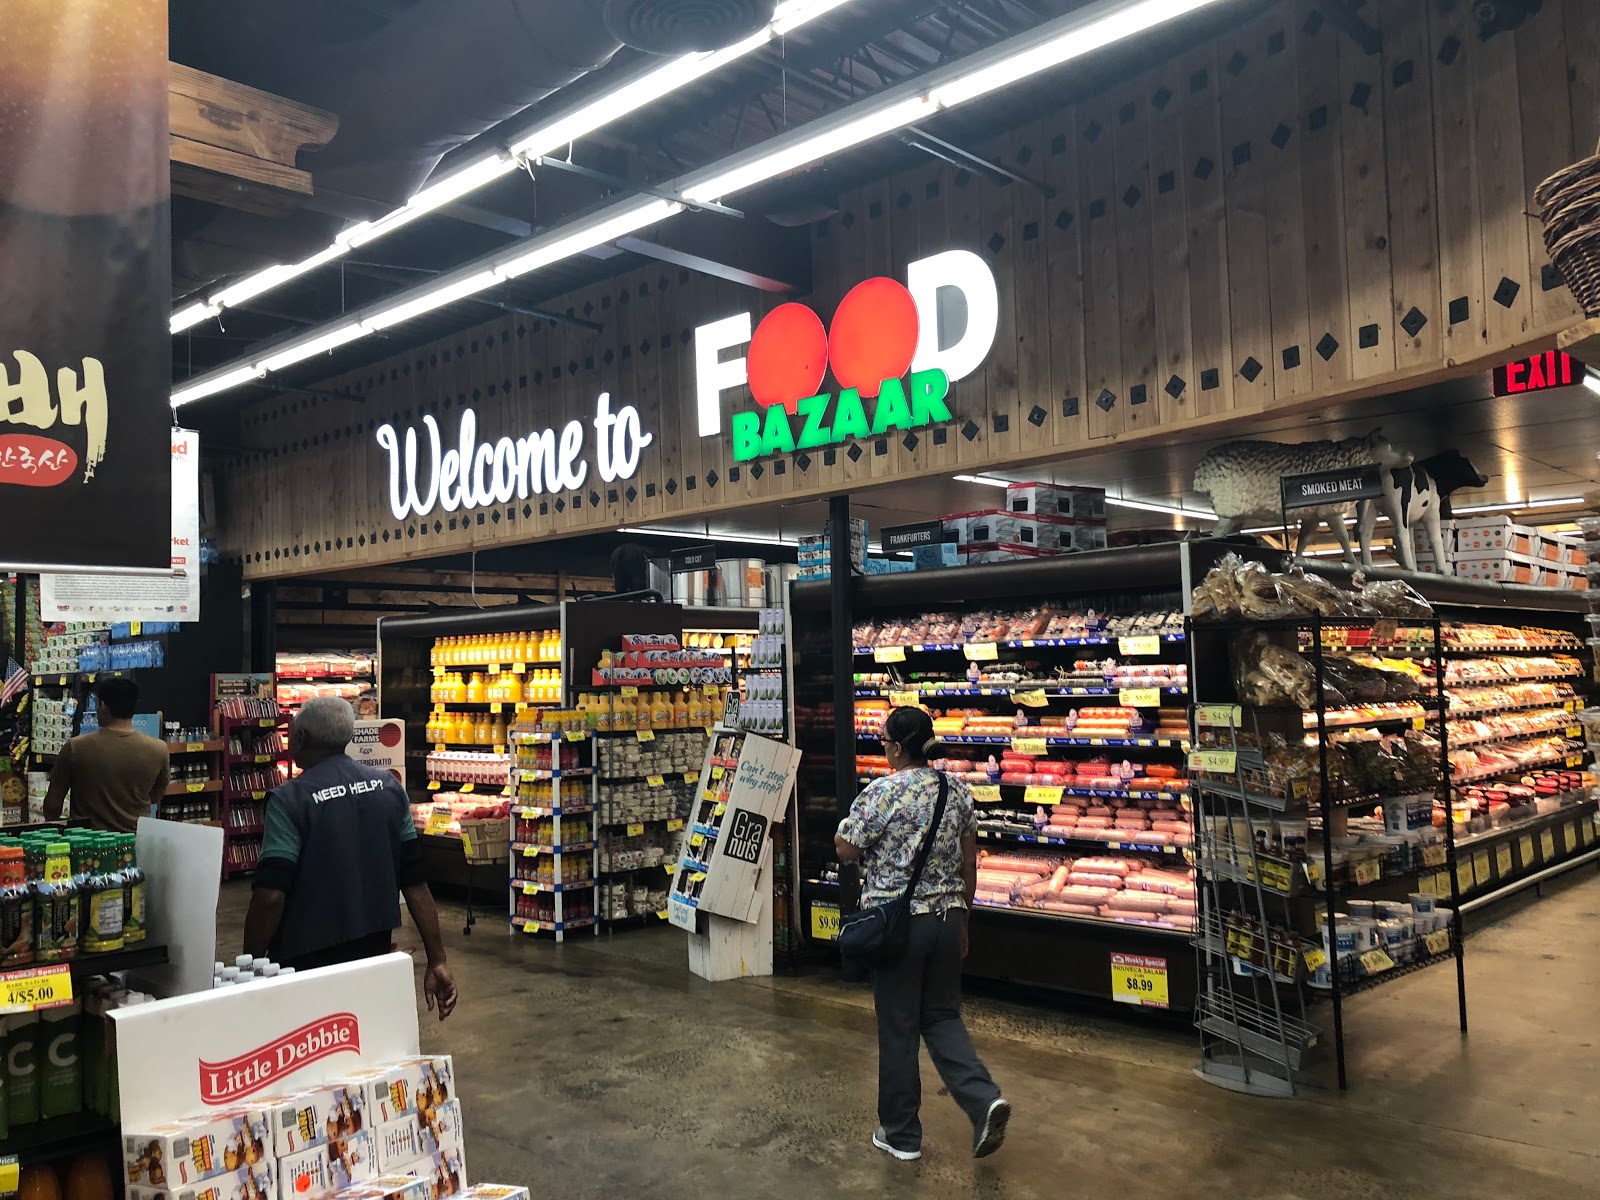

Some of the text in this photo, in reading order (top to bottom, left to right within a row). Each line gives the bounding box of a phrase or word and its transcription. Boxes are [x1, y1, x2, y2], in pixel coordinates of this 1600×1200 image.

[695, 249, 998, 437] FOOD
[1506, 349, 1571, 393] EXIT
[732, 367, 952, 462] BAZAAR
[376, 392, 652, 520] Welcome to
[1301, 478, 1363, 496] SMOKED MEAT
[890, 531, 931, 545] FRANKFURTERS
[685, 556, 694, 564] COLD
[354, 728, 379, 736] SHADE
[354, 735, 380, 743] FARMS
[741, 760, 766, 776] Can't
[312, 779, 384, 804] NEED HELP?
[740, 774, 783, 794] why stop?
[733, 811, 763, 844] Gra
[728, 838, 758, 861] nuts
[1113, 965, 1142, 973] INDUVECA
[1144, 968, 1166, 976] SALAMI
[1125, 956, 1165, 968] Weekly Special
[7, 965, 67, 981] Weekly Special
[1127, 977, 1153, 991] $8.99
[8, 986, 54, 1004] 4/$5.00
[209, 1023, 350, 1097] Little Debbie
